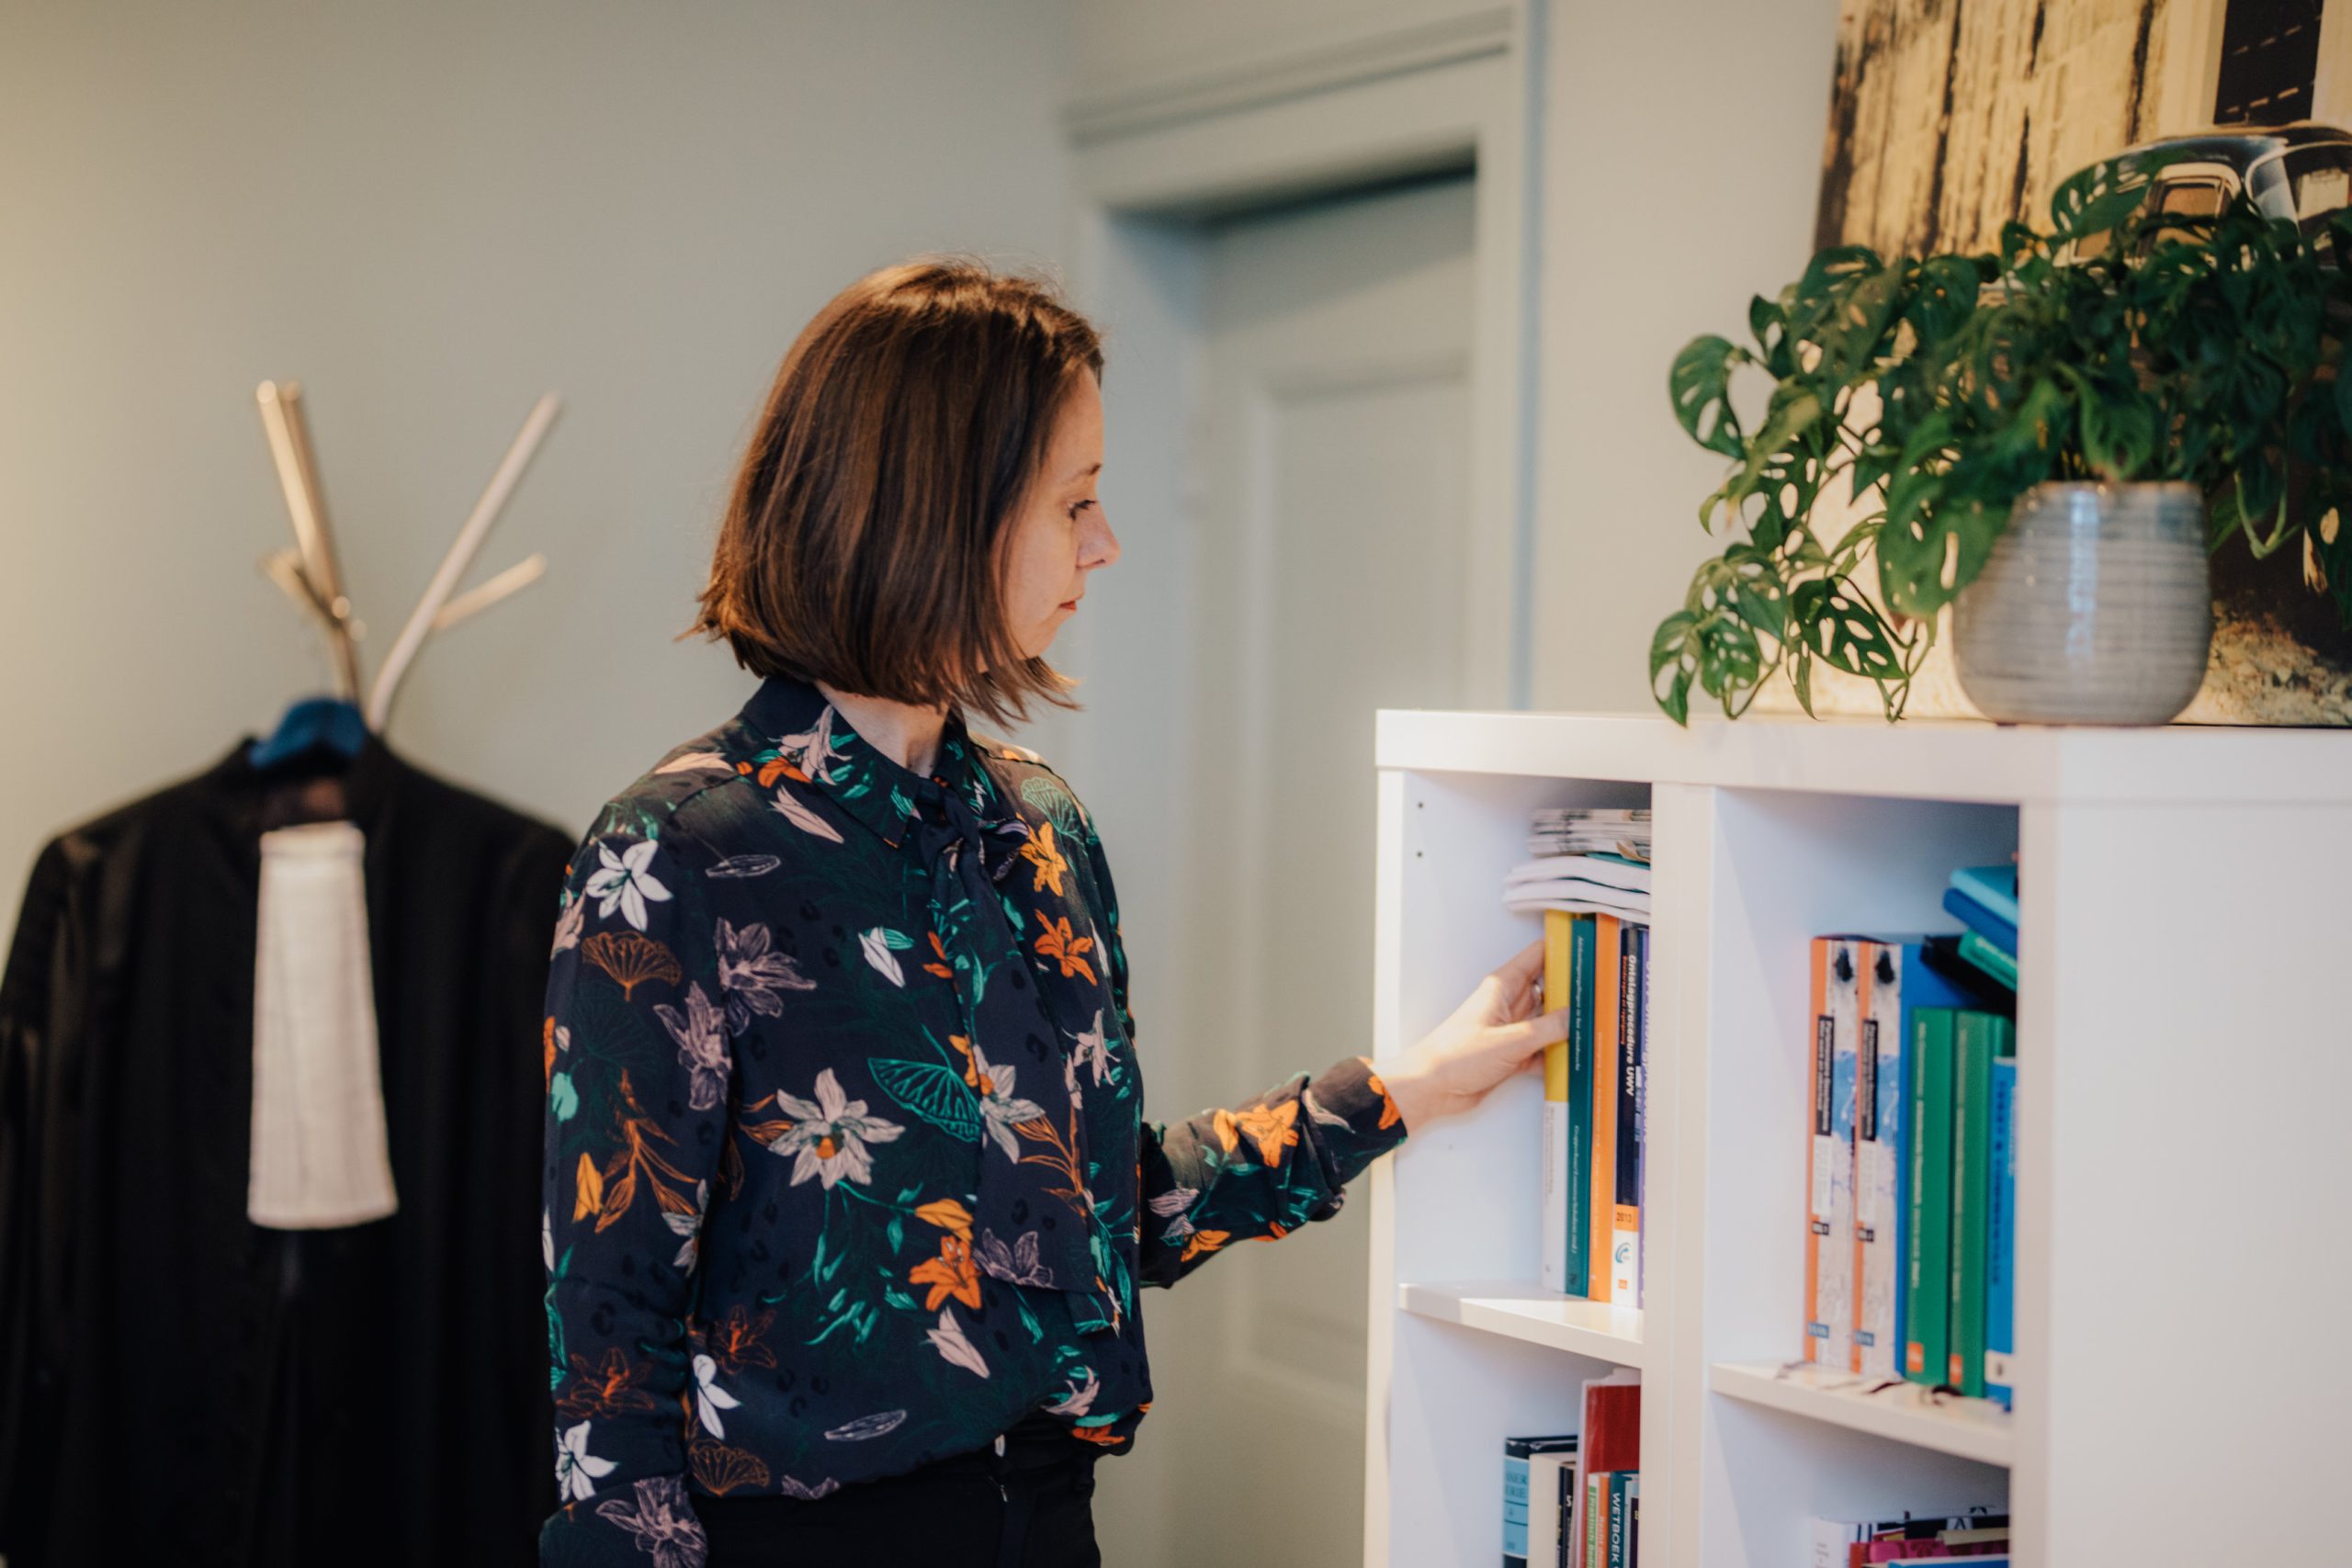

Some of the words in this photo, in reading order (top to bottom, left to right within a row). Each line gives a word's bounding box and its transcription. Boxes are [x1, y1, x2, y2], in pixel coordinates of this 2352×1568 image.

[1625, 954, 1637, 1064] Ontslagprocedure
[1625, 1066, 1636, 1097] UWV
[1611, 1493, 1621, 1562] WETBOEK
